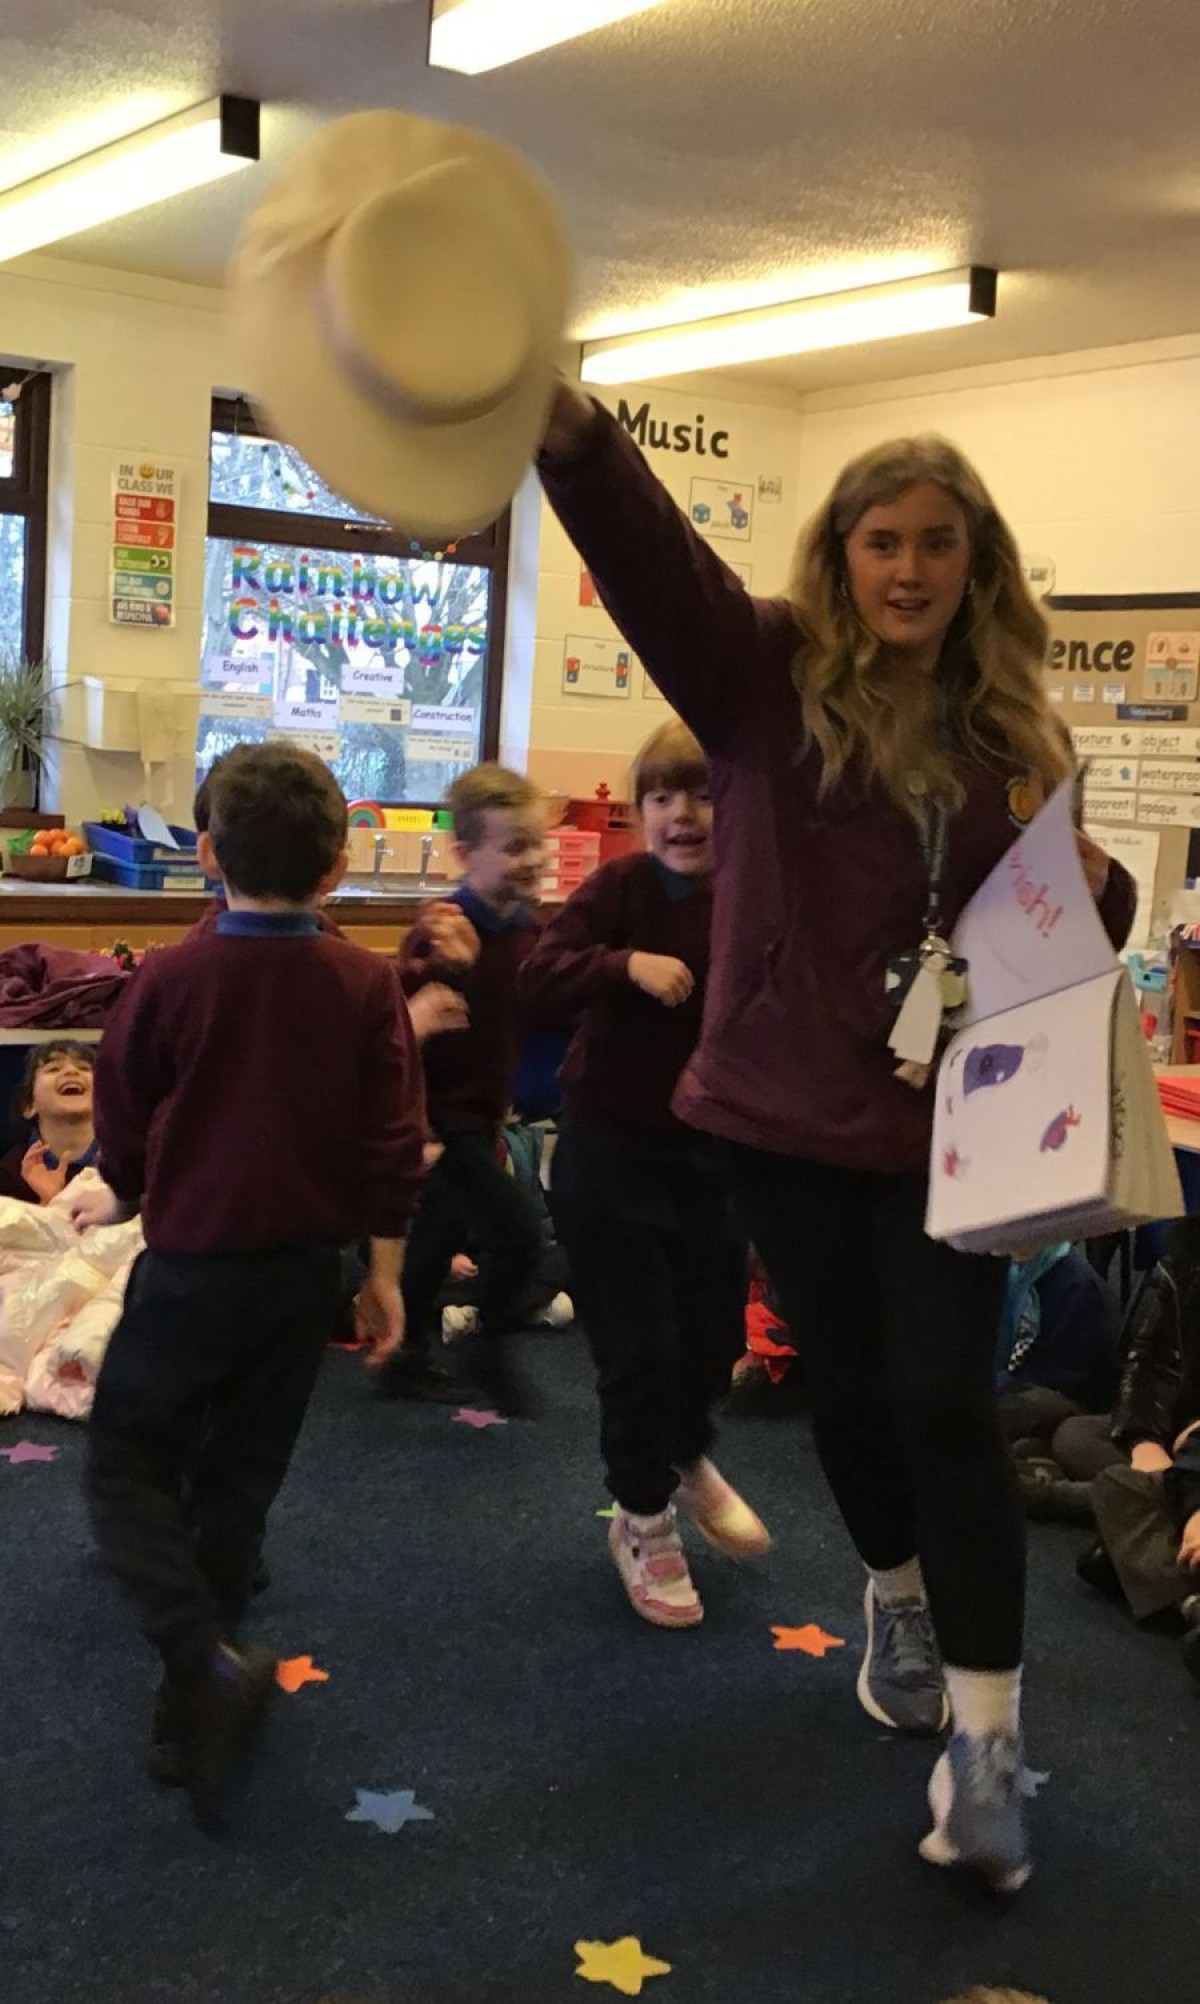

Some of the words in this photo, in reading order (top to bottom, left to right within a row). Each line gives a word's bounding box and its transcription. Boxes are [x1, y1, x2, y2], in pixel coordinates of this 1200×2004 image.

[618, 399, 730, 459] Music
[119, 464, 134, 477] IN
[117, 478, 154, 493] CLASS
[155, 482, 174, 494] WE
[232, 546, 441, 607] Rainbow
[228, 597, 487, 667] Challenges
[1050, 639, 1135, 672] ence
[222, 660, 259, 675] English
[352, 669, 393, 682] Creative
[291, 706, 322, 718] Maths
[414, 708, 473, 721] Construction
[1143, 736, 1181, 753] object
[1086, 765, 1113, 778] erial
[1141, 769, 1200, 786] waterproo
[1083, 799, 1129, 813] nsparent
